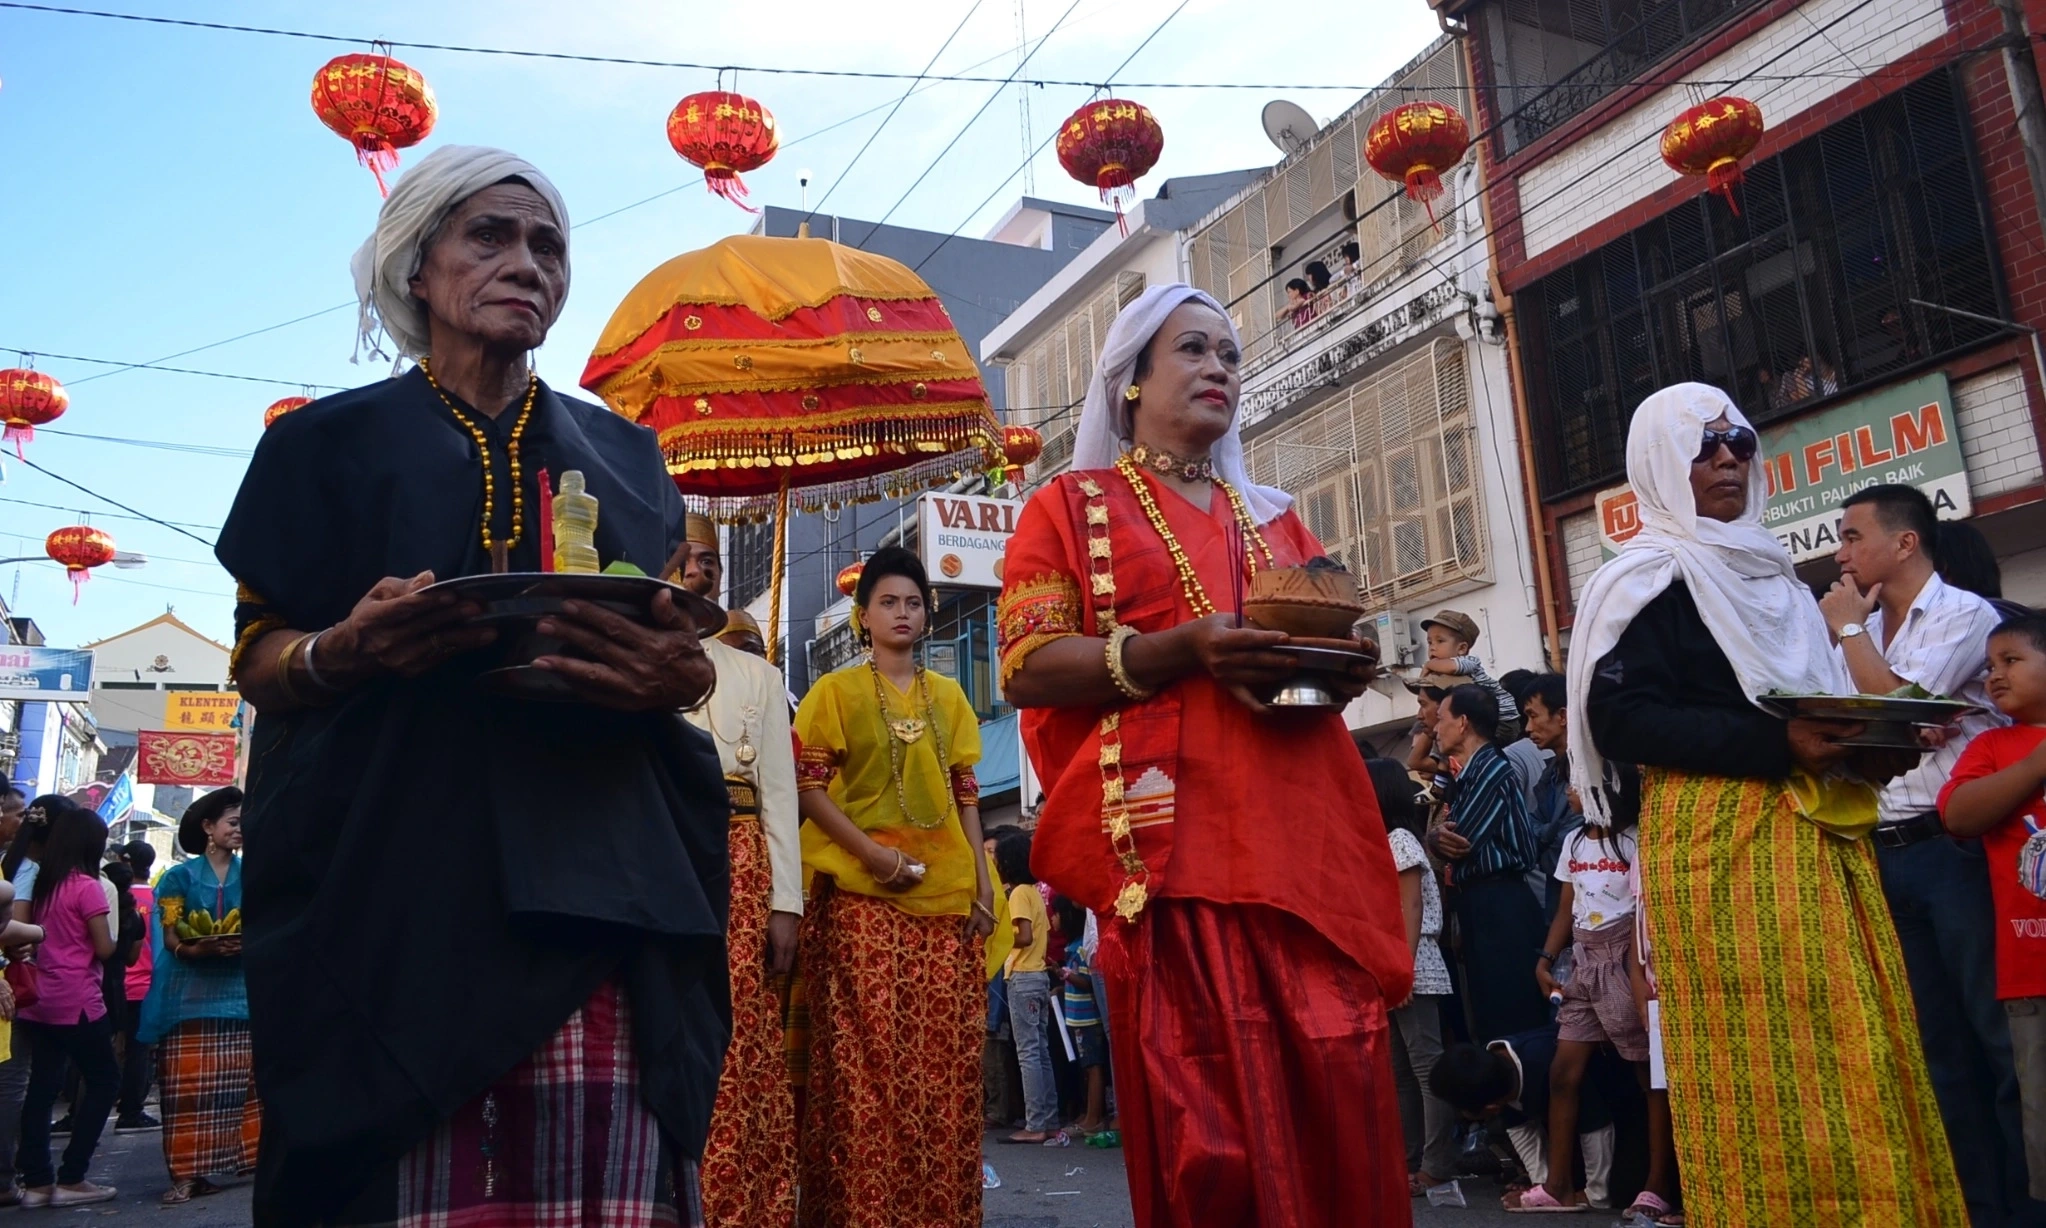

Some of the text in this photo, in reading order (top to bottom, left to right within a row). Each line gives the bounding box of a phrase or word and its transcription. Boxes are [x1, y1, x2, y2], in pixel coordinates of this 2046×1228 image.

[1803, 401, 1948, 487] FILM
[1761, 462, 1925, 524] RBUKTI PALING BAIK
